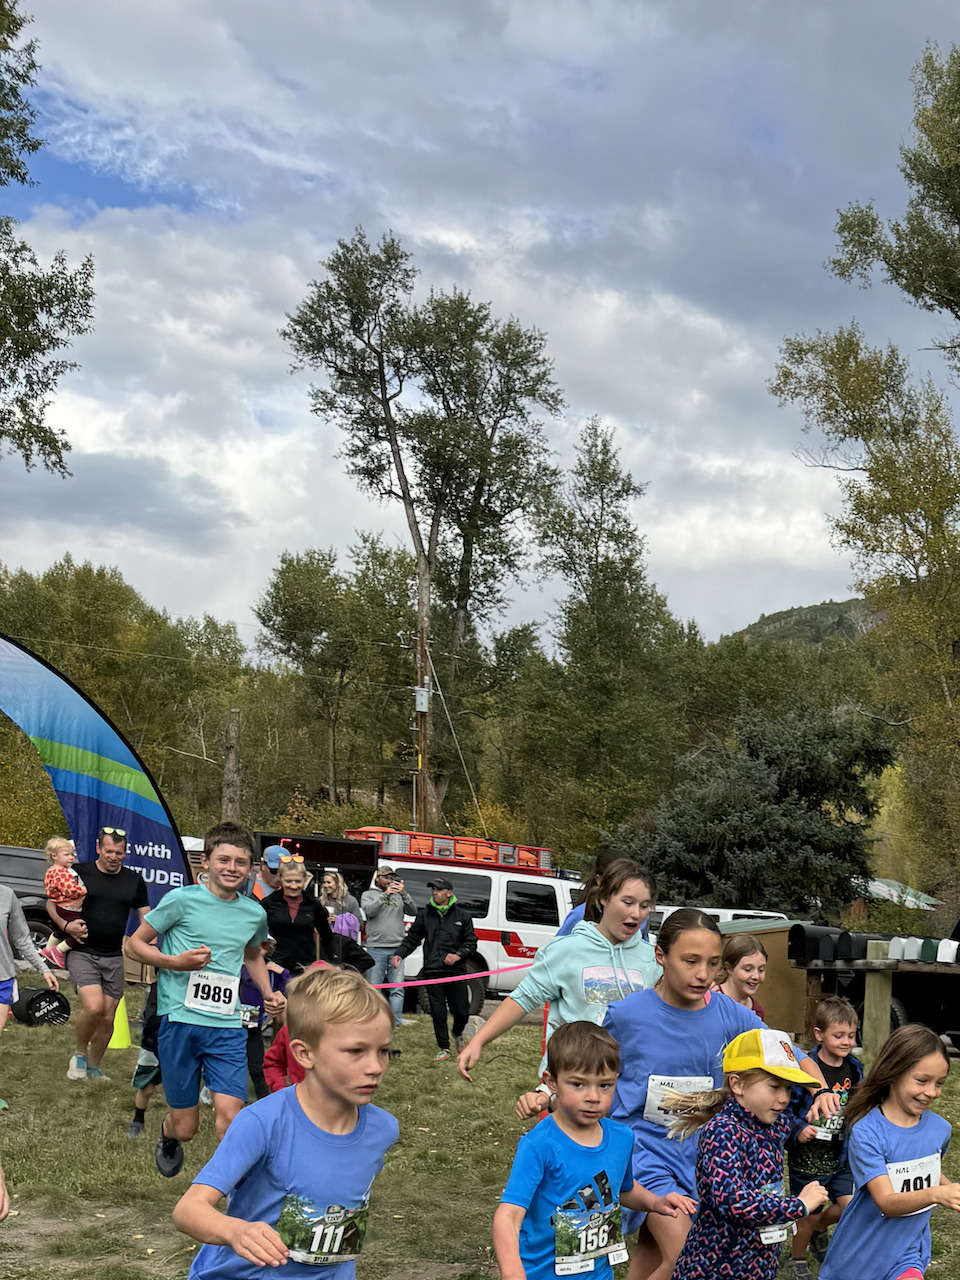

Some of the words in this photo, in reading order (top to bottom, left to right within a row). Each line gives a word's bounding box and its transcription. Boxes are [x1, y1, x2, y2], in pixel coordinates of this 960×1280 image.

[134, 841, 172, 860] with
[192, 982, 233, 1005] 1989
[310, 1224, 345, 1253] 111
[578, 1224, 609, 1253] 156
